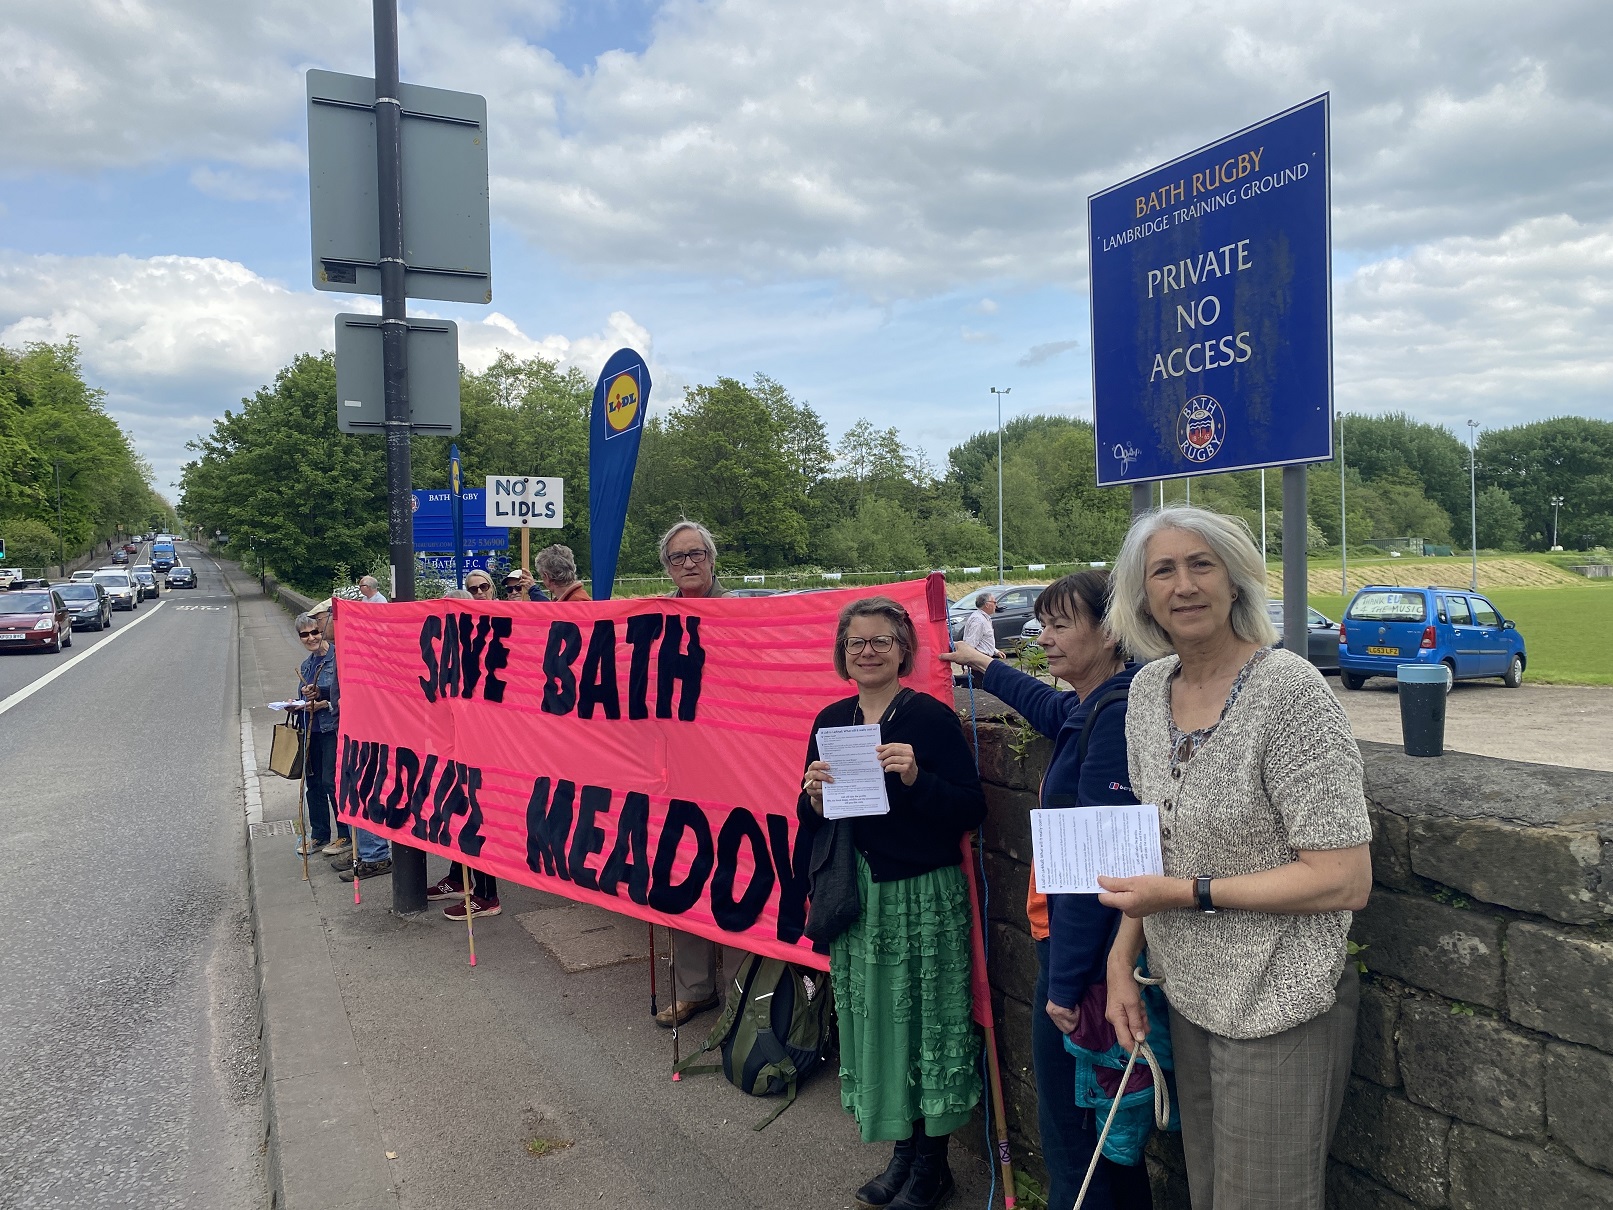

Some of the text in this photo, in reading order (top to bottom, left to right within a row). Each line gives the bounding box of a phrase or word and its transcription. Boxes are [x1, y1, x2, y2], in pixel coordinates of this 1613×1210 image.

[1136, 146, 1264, 219] BATH RUGBY
[1103, 162, 1309, 252] LAMBRIDGE TRAINING GROUND
[1147, 238, 1253, 299] PRIVATE
[1176, 295, 1221, 333] NO
[1149, 331, 1252, 383] ACCESS
[1182, 397, 1217, 419] BATH
[1180, 434, 1221, 461] RUGBY
[429, 494, 451, 502] BATH
[495, 479, 547, 498] NO 2
[495, 500, 556, 519] LIDLS
[462, 538, 505, 547] 225 536900
[1362, 594, 1400, 605] THANK EU
[1371, 605, 1388, 613] THE
[1391, 604, 1423, 614] MUSIC
[418, 612, 706, 721] SAVE BATH
[338, 733, 486, 857] WILDLIFE
